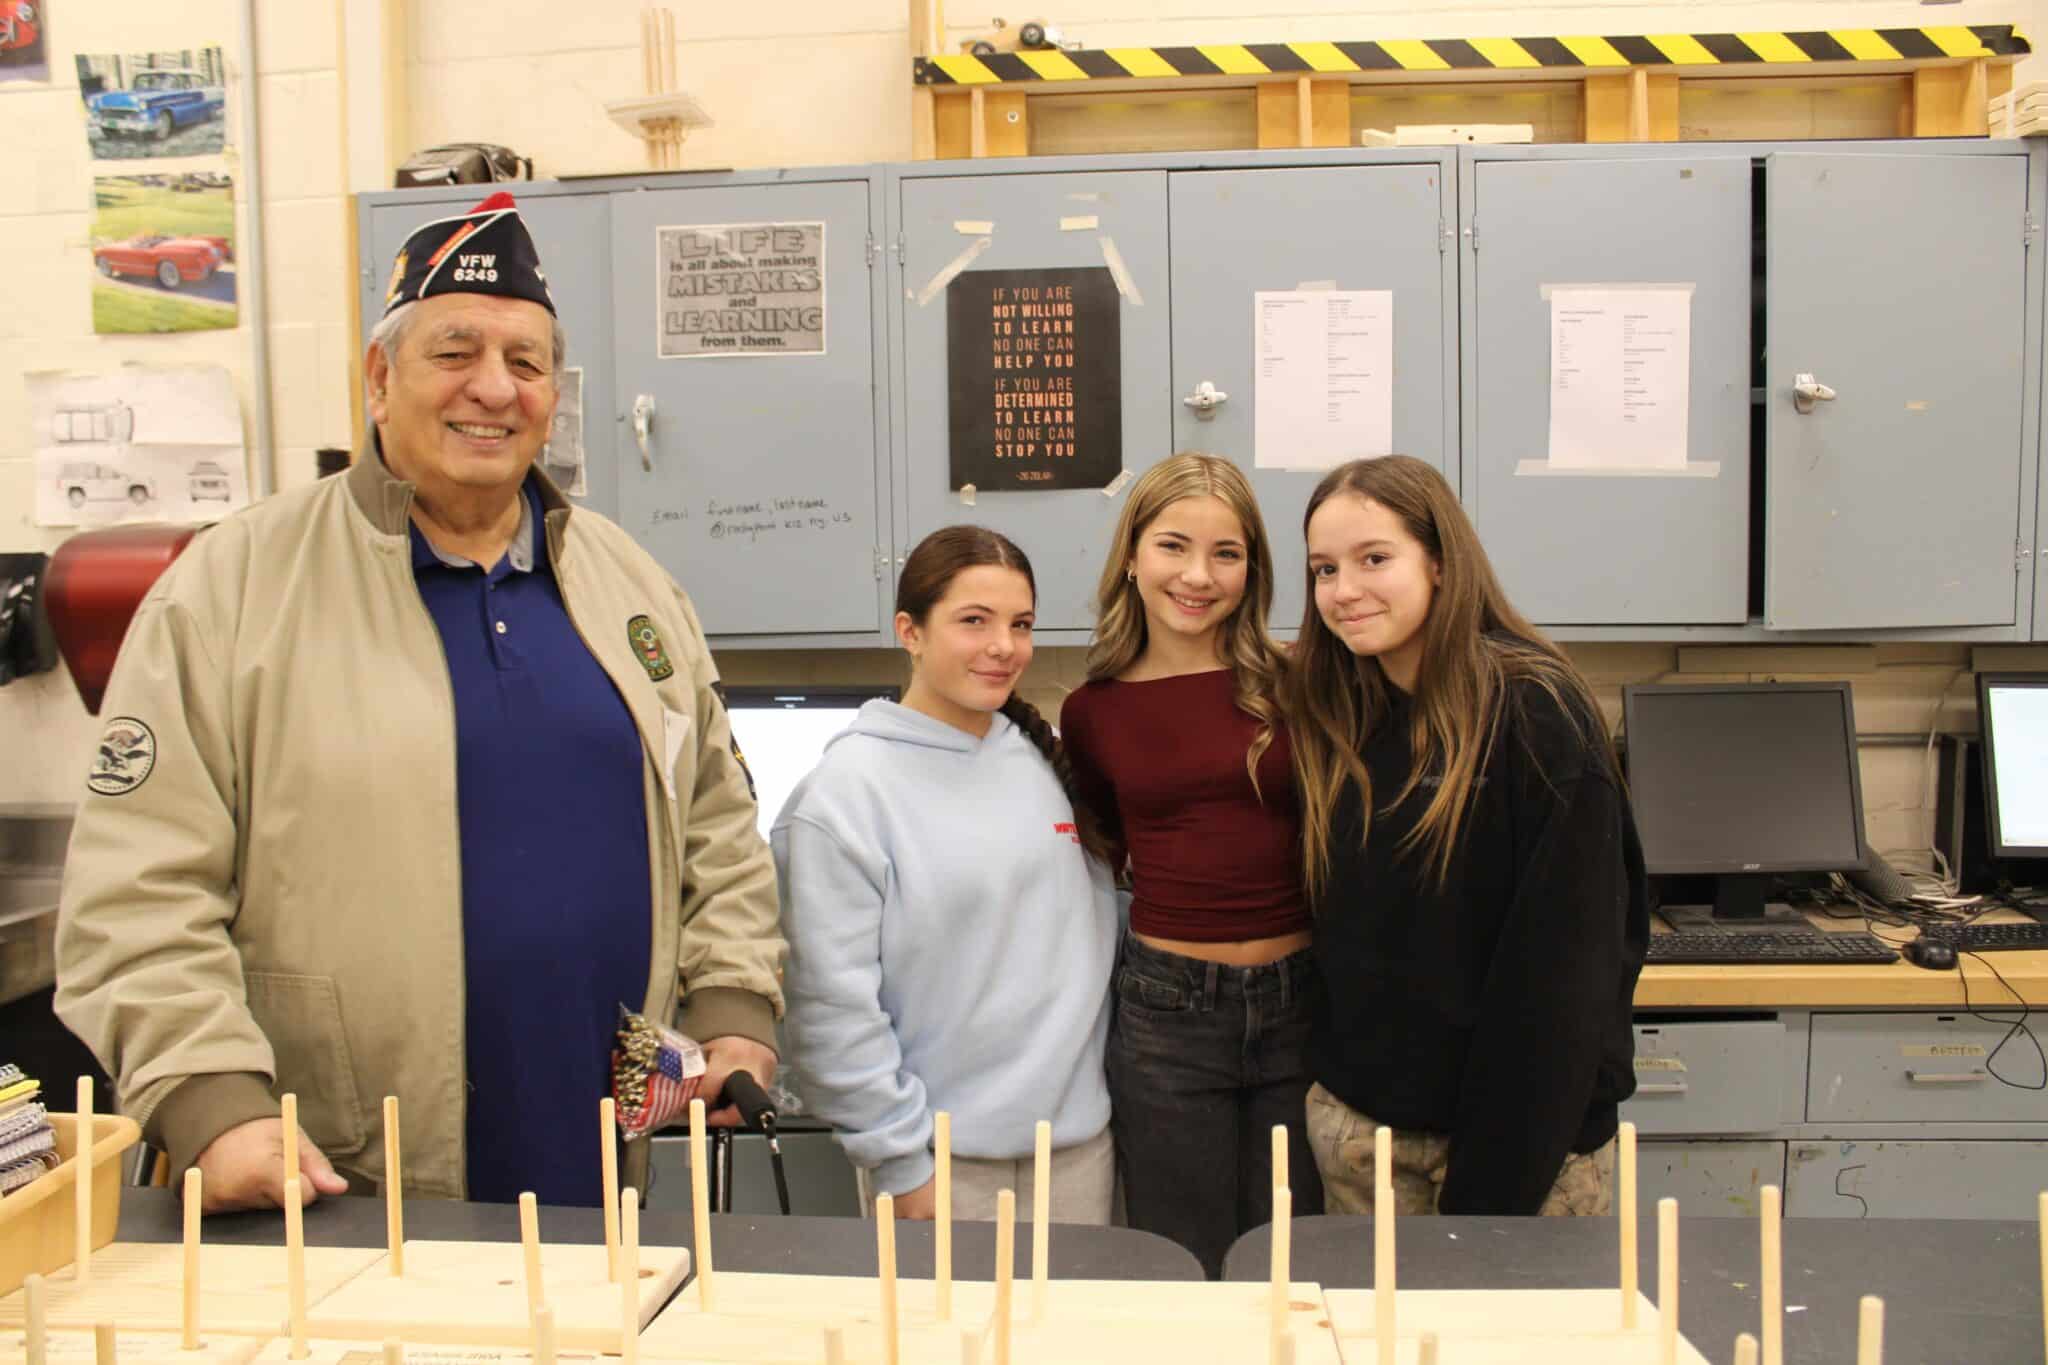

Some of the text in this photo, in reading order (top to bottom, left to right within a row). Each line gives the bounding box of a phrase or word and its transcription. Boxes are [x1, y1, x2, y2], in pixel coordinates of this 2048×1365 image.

[678, 230, 806, 259] LIFE
[459, 254, 496, 268] VFW
[670, 256, 816, 272] is all about making
[453, 269, 498, 282] 6249
[667, 270, 821, 298] MISTAKES
[993, 286, 1072, 301] IF YOU ARE
[729, 296, 757, 307] and
[993, 303, 1073, 318] NOT WILLING
[665, 307, 822, 335] LEARNING
[993, 320, 1073, 335] TO LEARN
[701, 335, 786, 347] from them.
[994, 337, 1073, 352] NO ONE CAN
[994, 354, 1073, 368] HELP YOU
[995, 377, 1072, 392] IF YOU ARE
[995, 392, 1073, 408] DETERMINED
[995, 410, 1074, 424] TO LEARN
[995, 426, 1074, 441] NO ONE CAN
[995, 443, 1074, 457] STOP YOU
